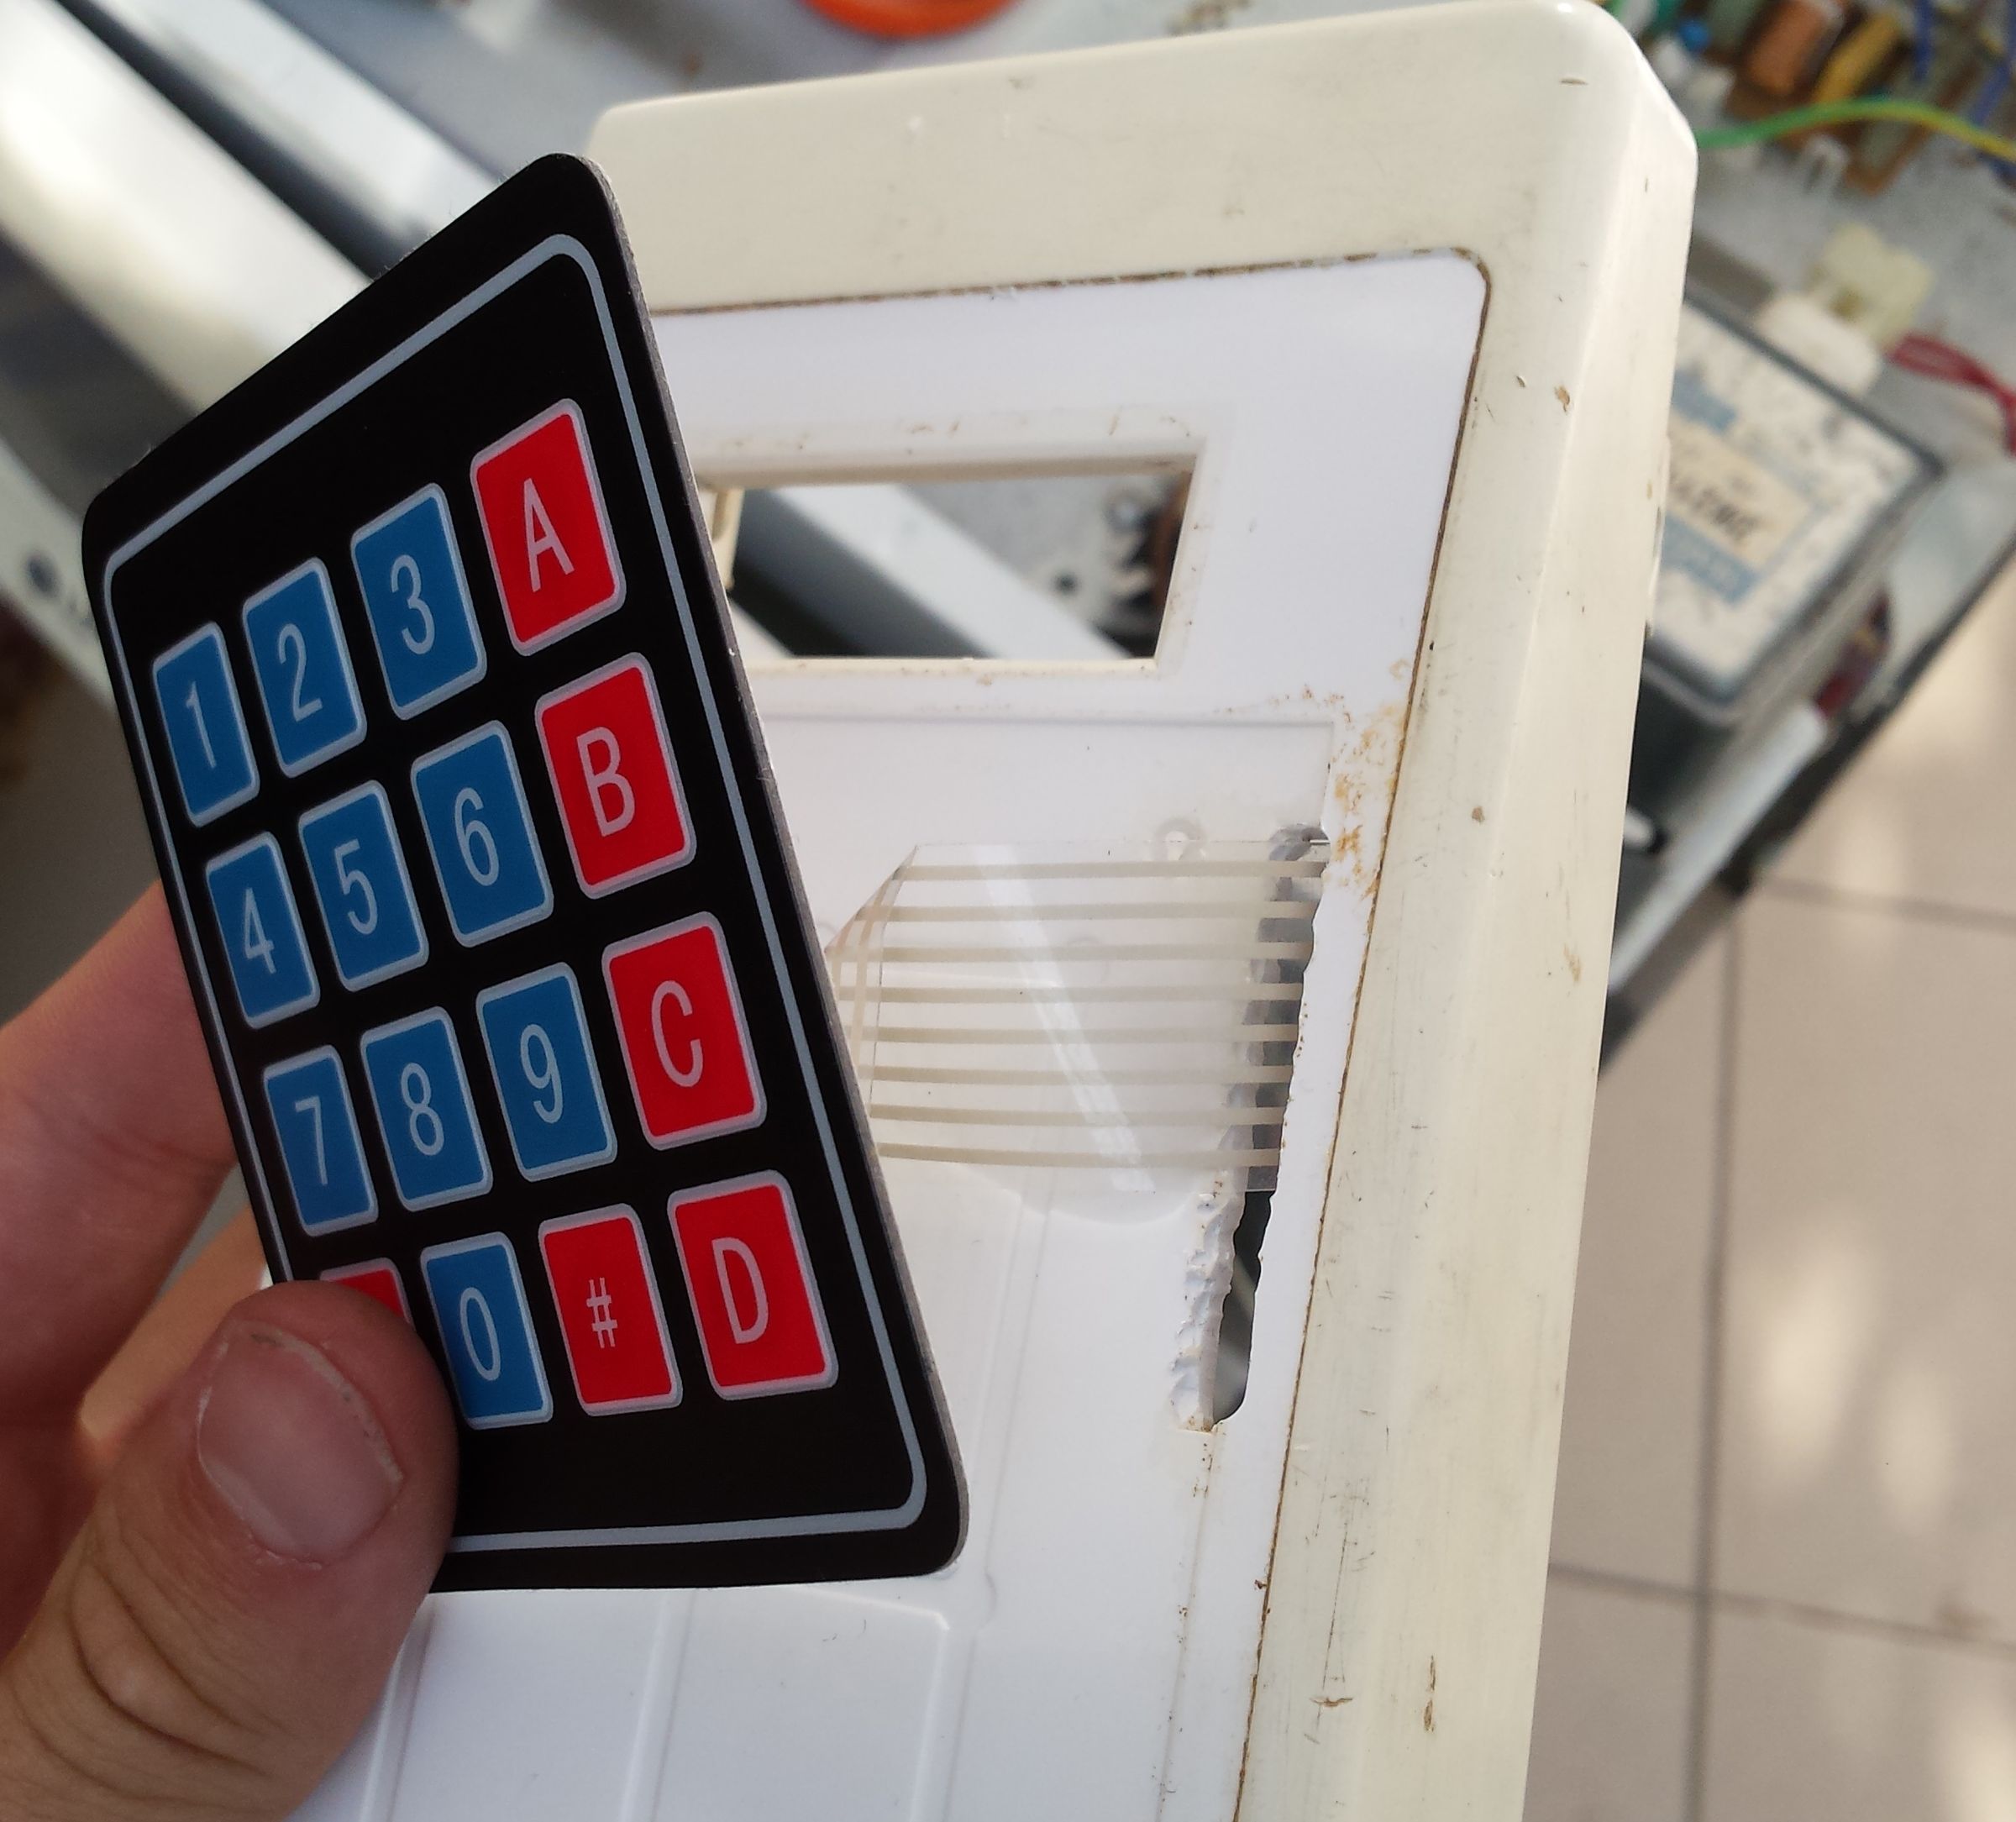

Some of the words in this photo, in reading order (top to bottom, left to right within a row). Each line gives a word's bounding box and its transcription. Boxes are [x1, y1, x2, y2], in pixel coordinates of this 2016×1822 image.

[186, 681, 218, 769] 1
[278, 624, 323, 722] 2
[390, 554, 435, 655] 3
[524, 478, 575, 591] A
[244, 887, 276, 974] 4
[334, 840, 377, 934] 5
[454, 788, 499, 885] 6
[576, 727, 635, 837] B
[295, 1096, 328, 1185] 7
[400, 1063, 444, 1156] 8
[520, 1024, 563, 1123] 9
[651, 980, 703, 1087] C
[459, 1287, 501, 1381] 0
[586, 1277, 618, 1349] #
[712, 1237, 769, 1344] D
